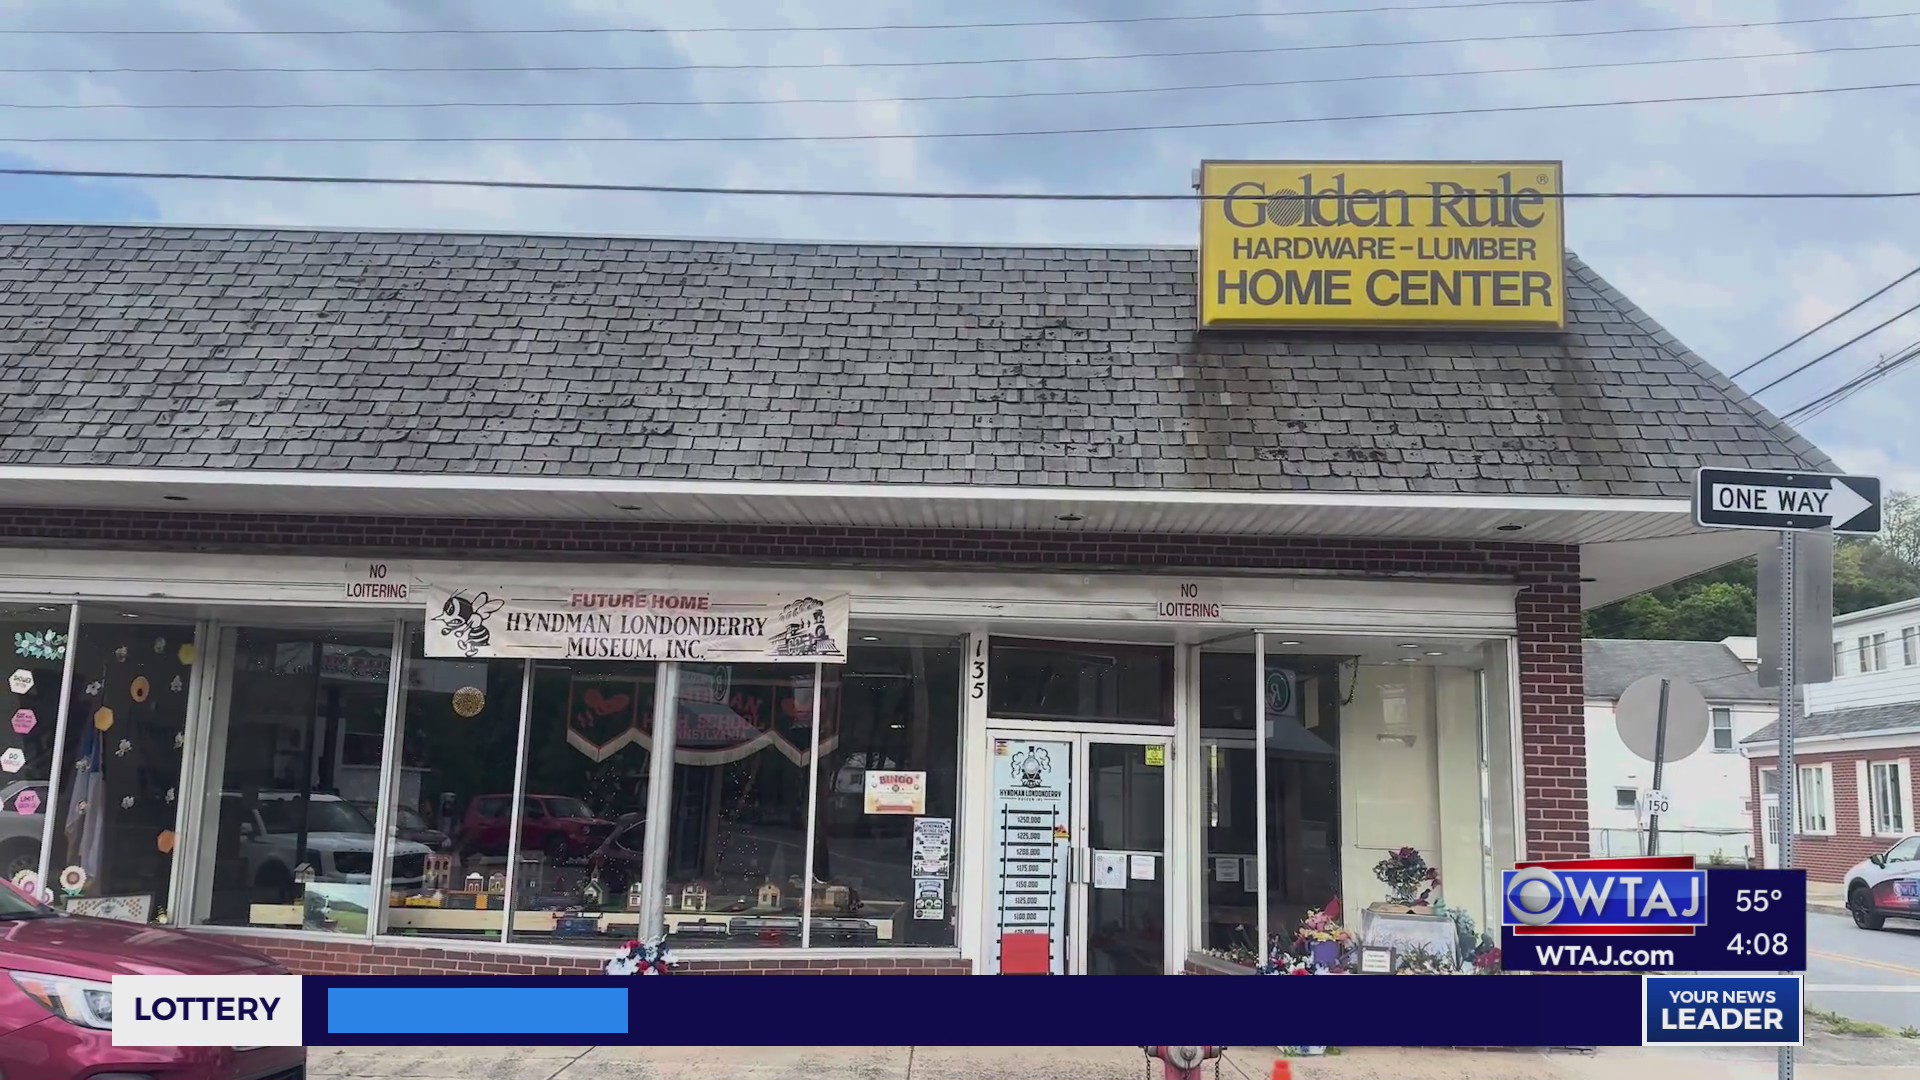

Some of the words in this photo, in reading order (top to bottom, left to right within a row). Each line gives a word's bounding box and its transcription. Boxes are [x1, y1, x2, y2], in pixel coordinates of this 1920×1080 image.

[1223, 172, 1414, 228] Golden
[1426, 171, 1546, 229] Rule
[1217, 268, 1352, 306] HOME
[1365, 268, 1553, 308] CENTER
[1718, 486, 1769, 511] ONE
[1777, 489, 1830, 514] WAY
[368, 563, 388, 579] NO
[345, 580, 408, 599] LOITERING
[1180, 583, 1199, 598] NO
[570, 593, 647, 609] FUTURE
[651, 595, 709, 610] HOME
[1158, 602, 1221, 618] LOITERING
[506, 612, 612, 634] HYNDMAN
[619, 614, 769, 637] LONDONDERRY
[565, 636, 657, 660] MUSEUM,
[665, 638, 706, 661] INC.
[879, 774, 914, 785] BINGO
[999, 789, 1025, 797] HYNDMAN
[1025, 790, 1062, 798] LONDONDERRY
[1649, 799, 1669, 813] 150
